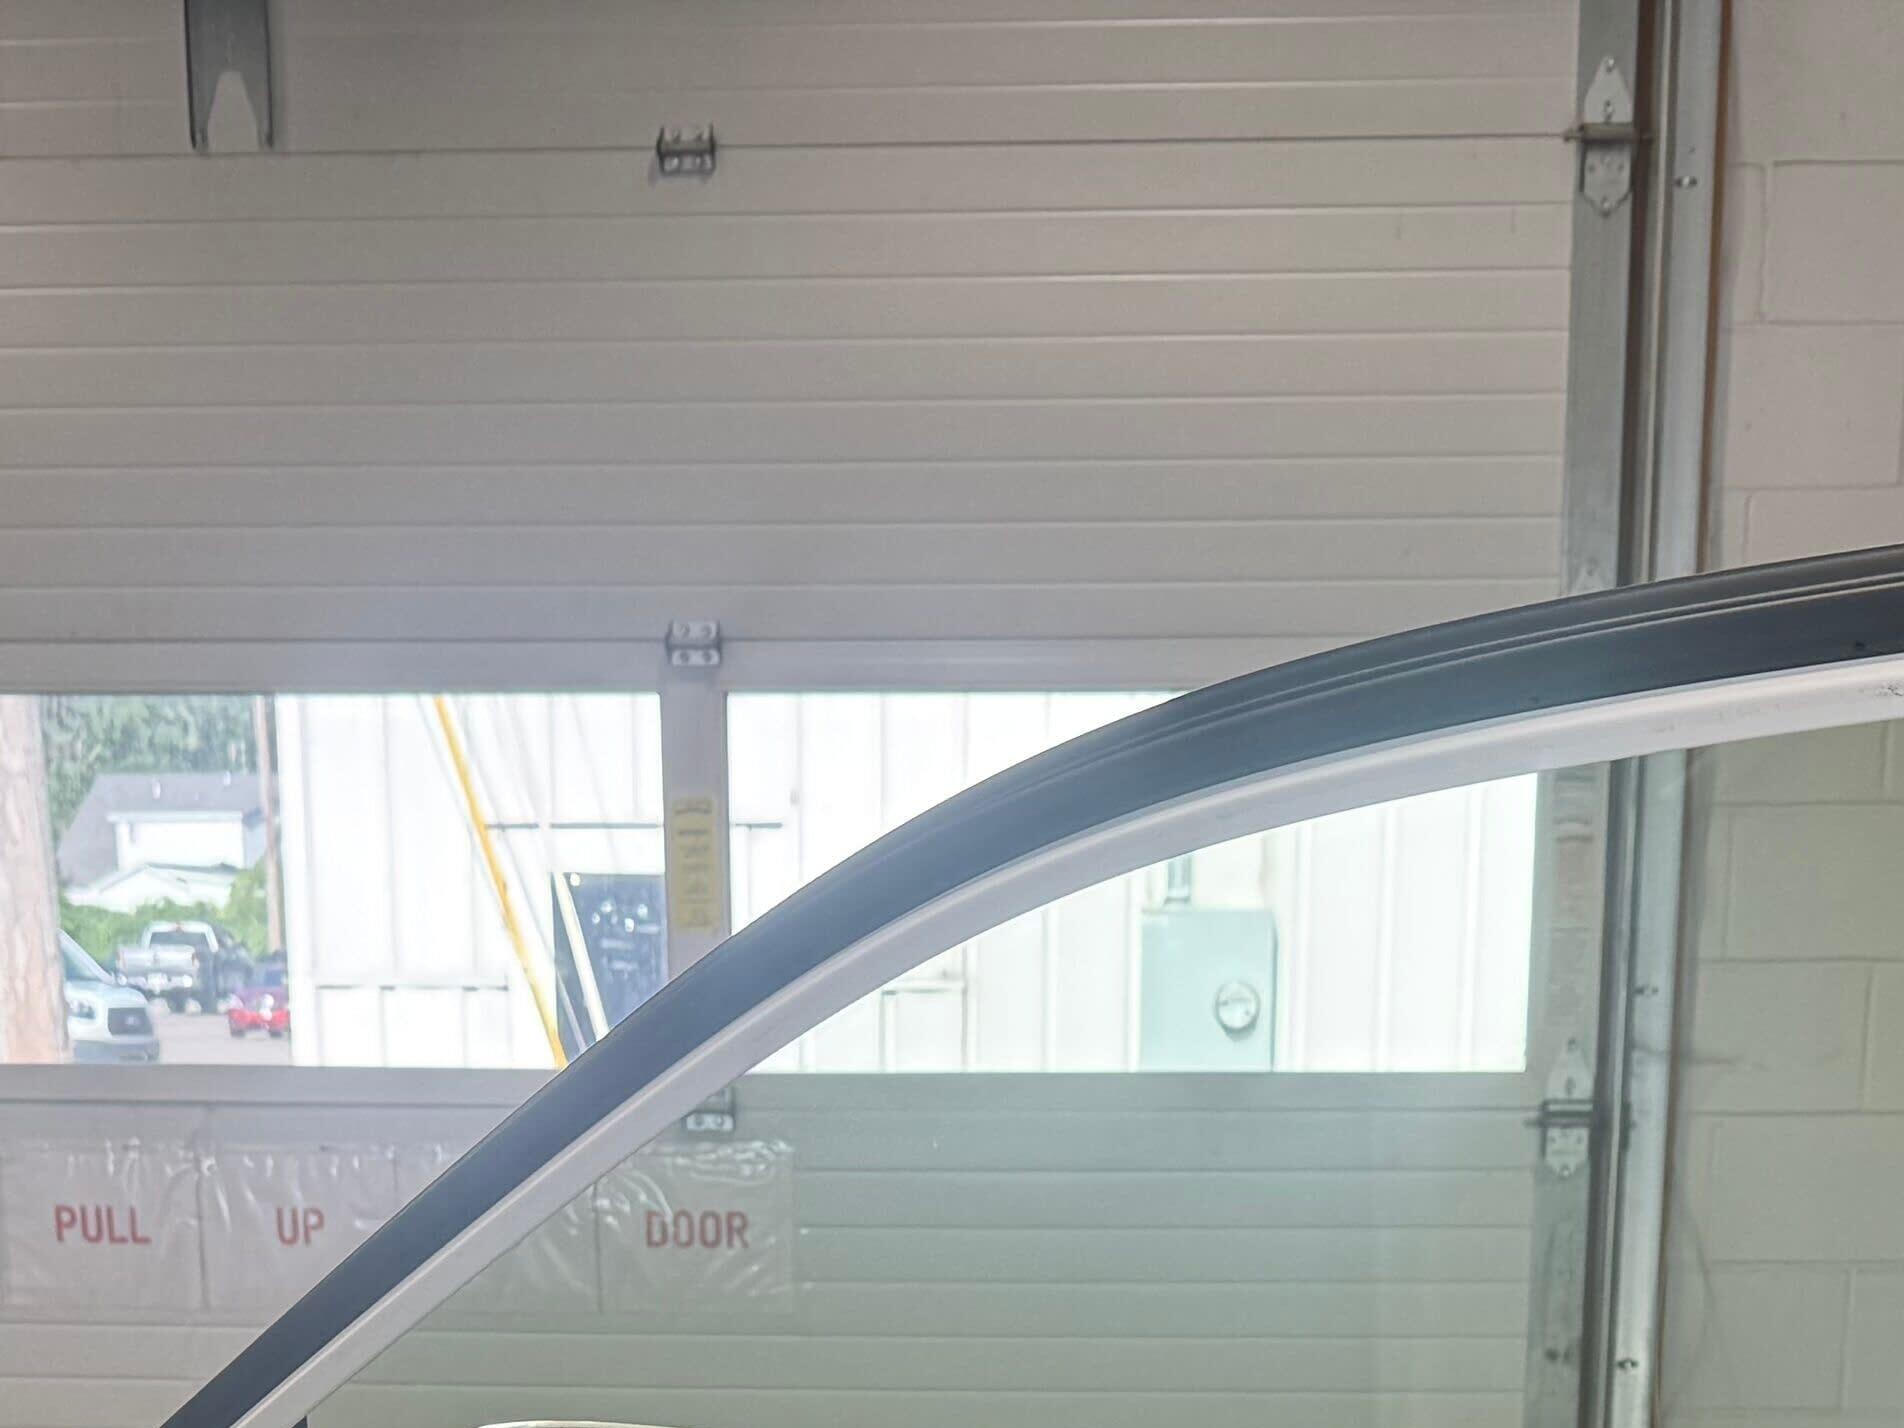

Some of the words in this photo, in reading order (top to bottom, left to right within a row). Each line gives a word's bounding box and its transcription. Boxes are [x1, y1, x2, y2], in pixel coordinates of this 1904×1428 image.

[53, 1204, 152, 1245] PULL
[275, 1207, 325, 1246] UP
[644, 1210, 749, 1250] DOOR
